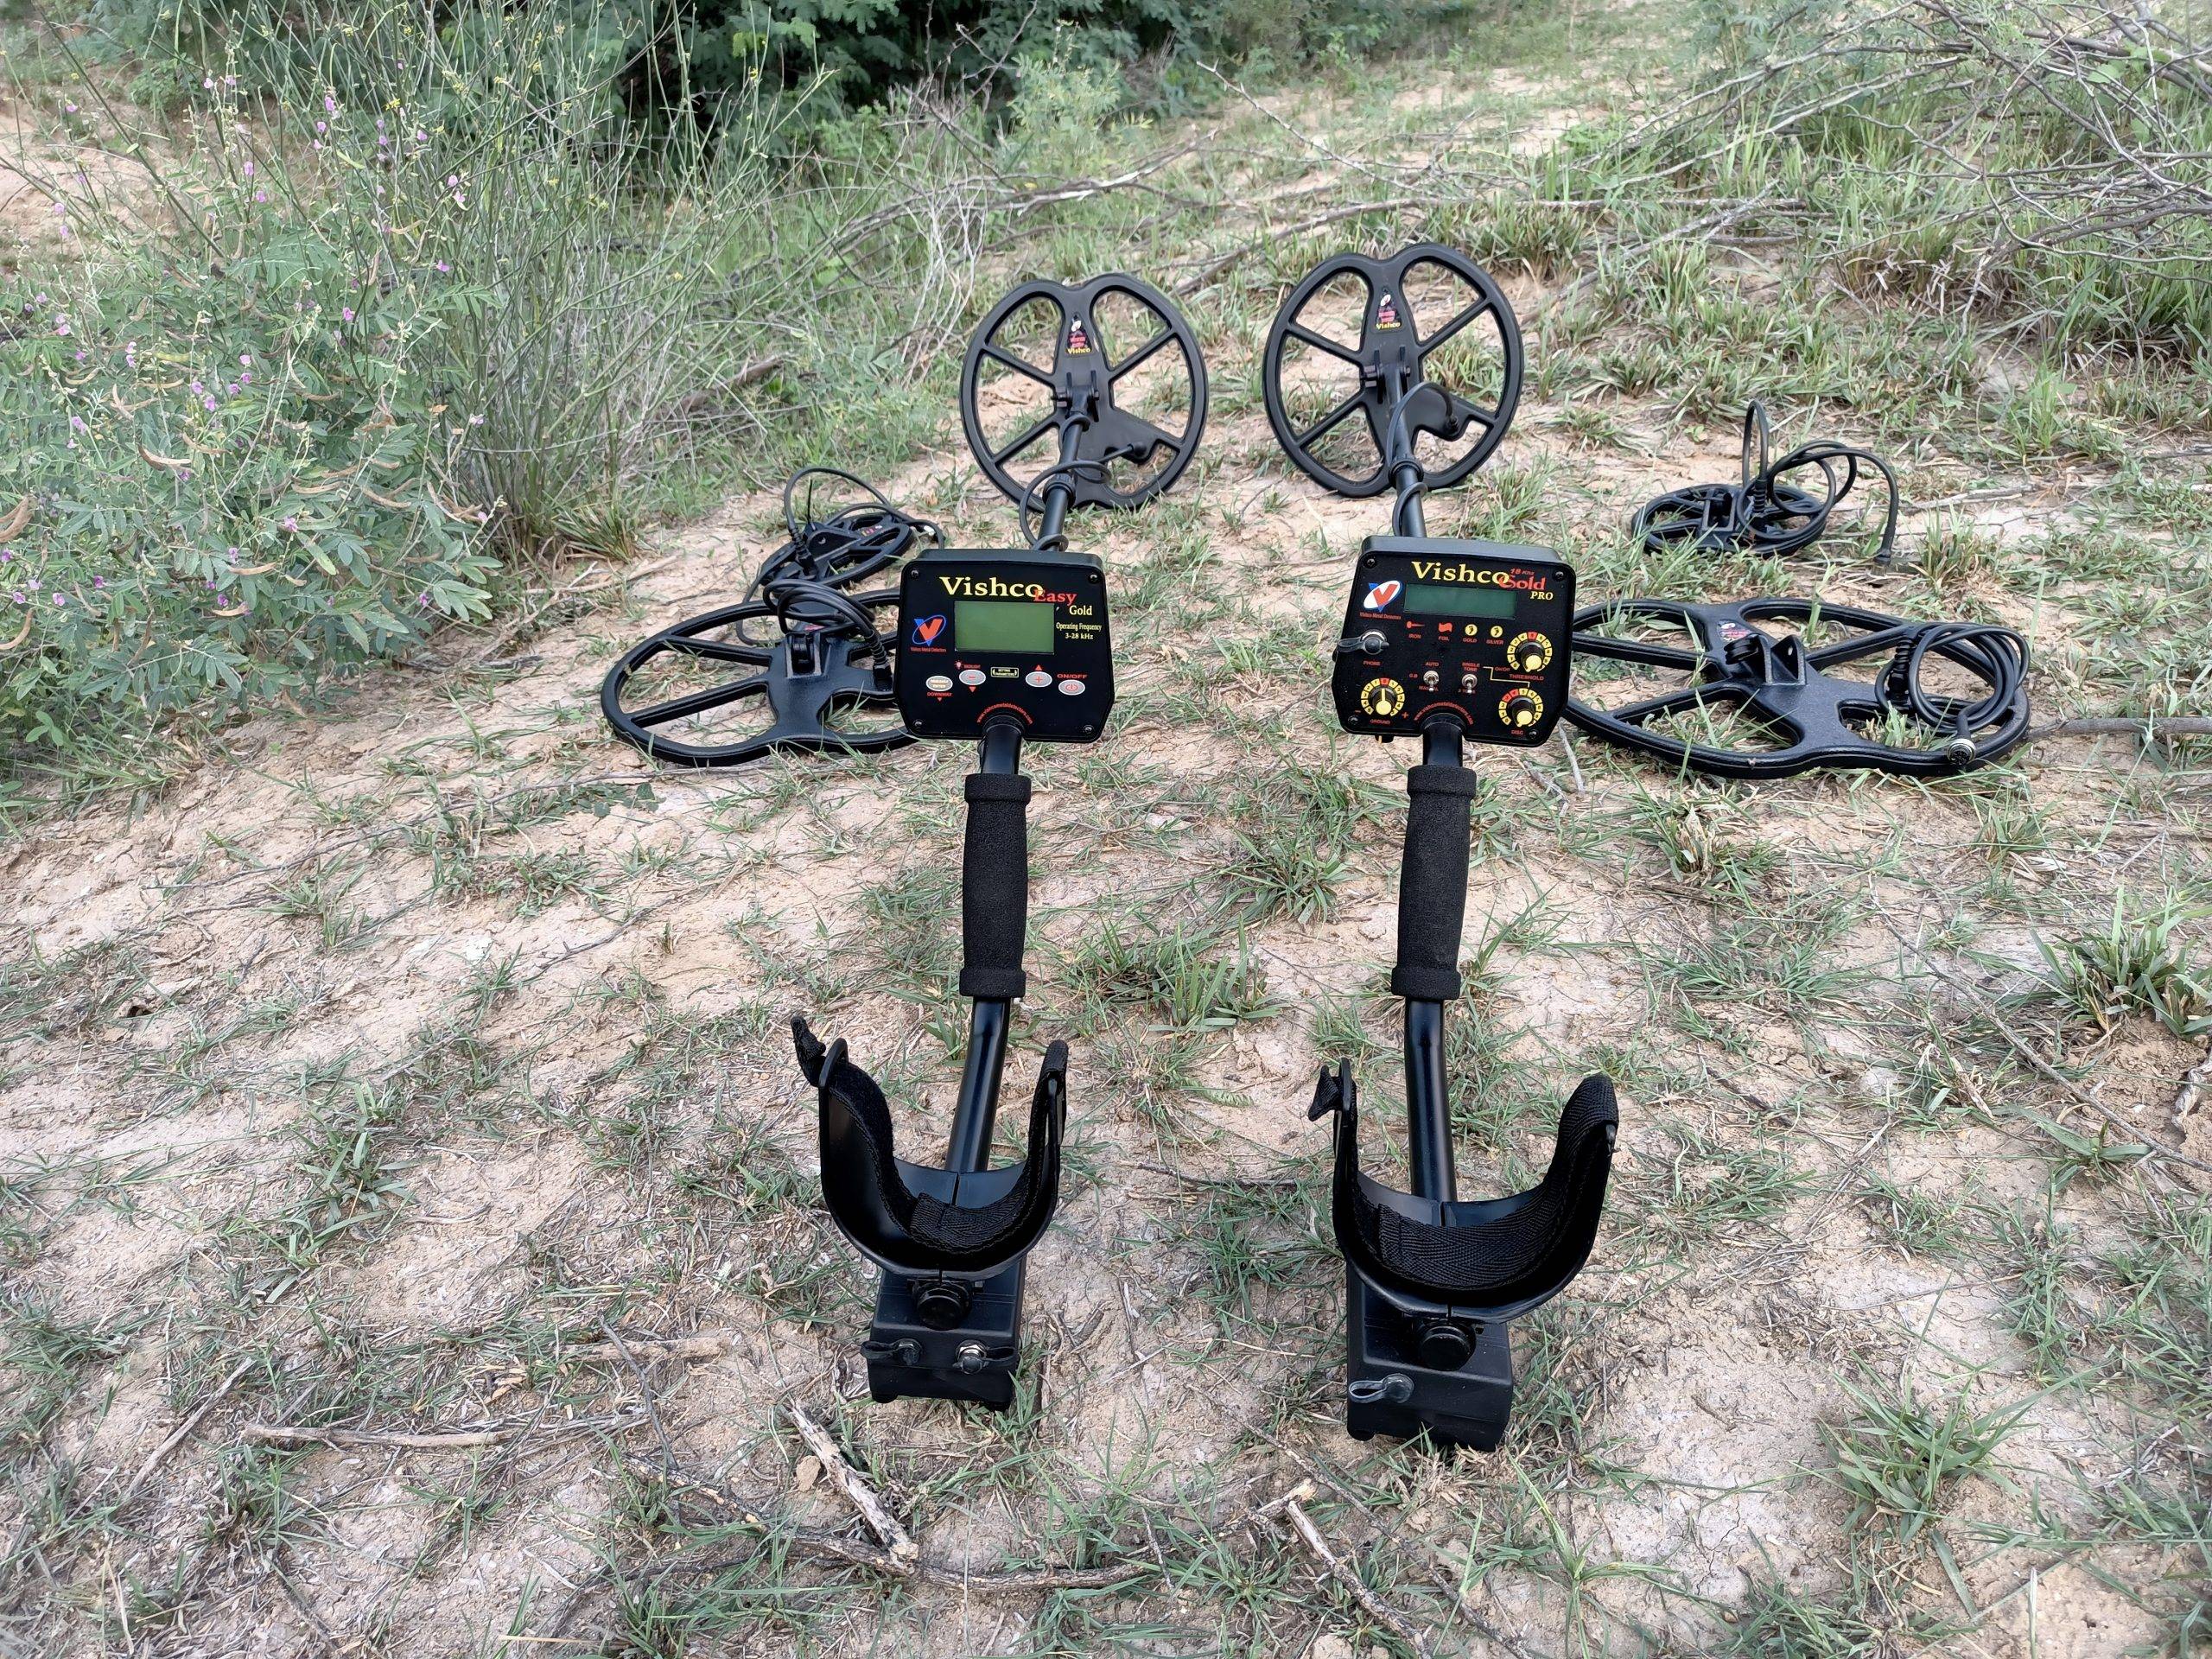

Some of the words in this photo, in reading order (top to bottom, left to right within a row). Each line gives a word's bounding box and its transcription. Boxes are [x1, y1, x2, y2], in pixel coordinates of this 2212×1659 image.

[1412, 561, 1510, 584] Vishco
[939, 576, 1044, 598] Vishco
[1499, 574, 1546, 590] Gold
[1033, 588, 1077, 606] Easy
[1530, 590, 1554, 601] PRO
[1069, 605, 1093, 616] Gold
[1056, 622, 1078, 632] Operating
[1079, 623, 1103, 632] Frequency
